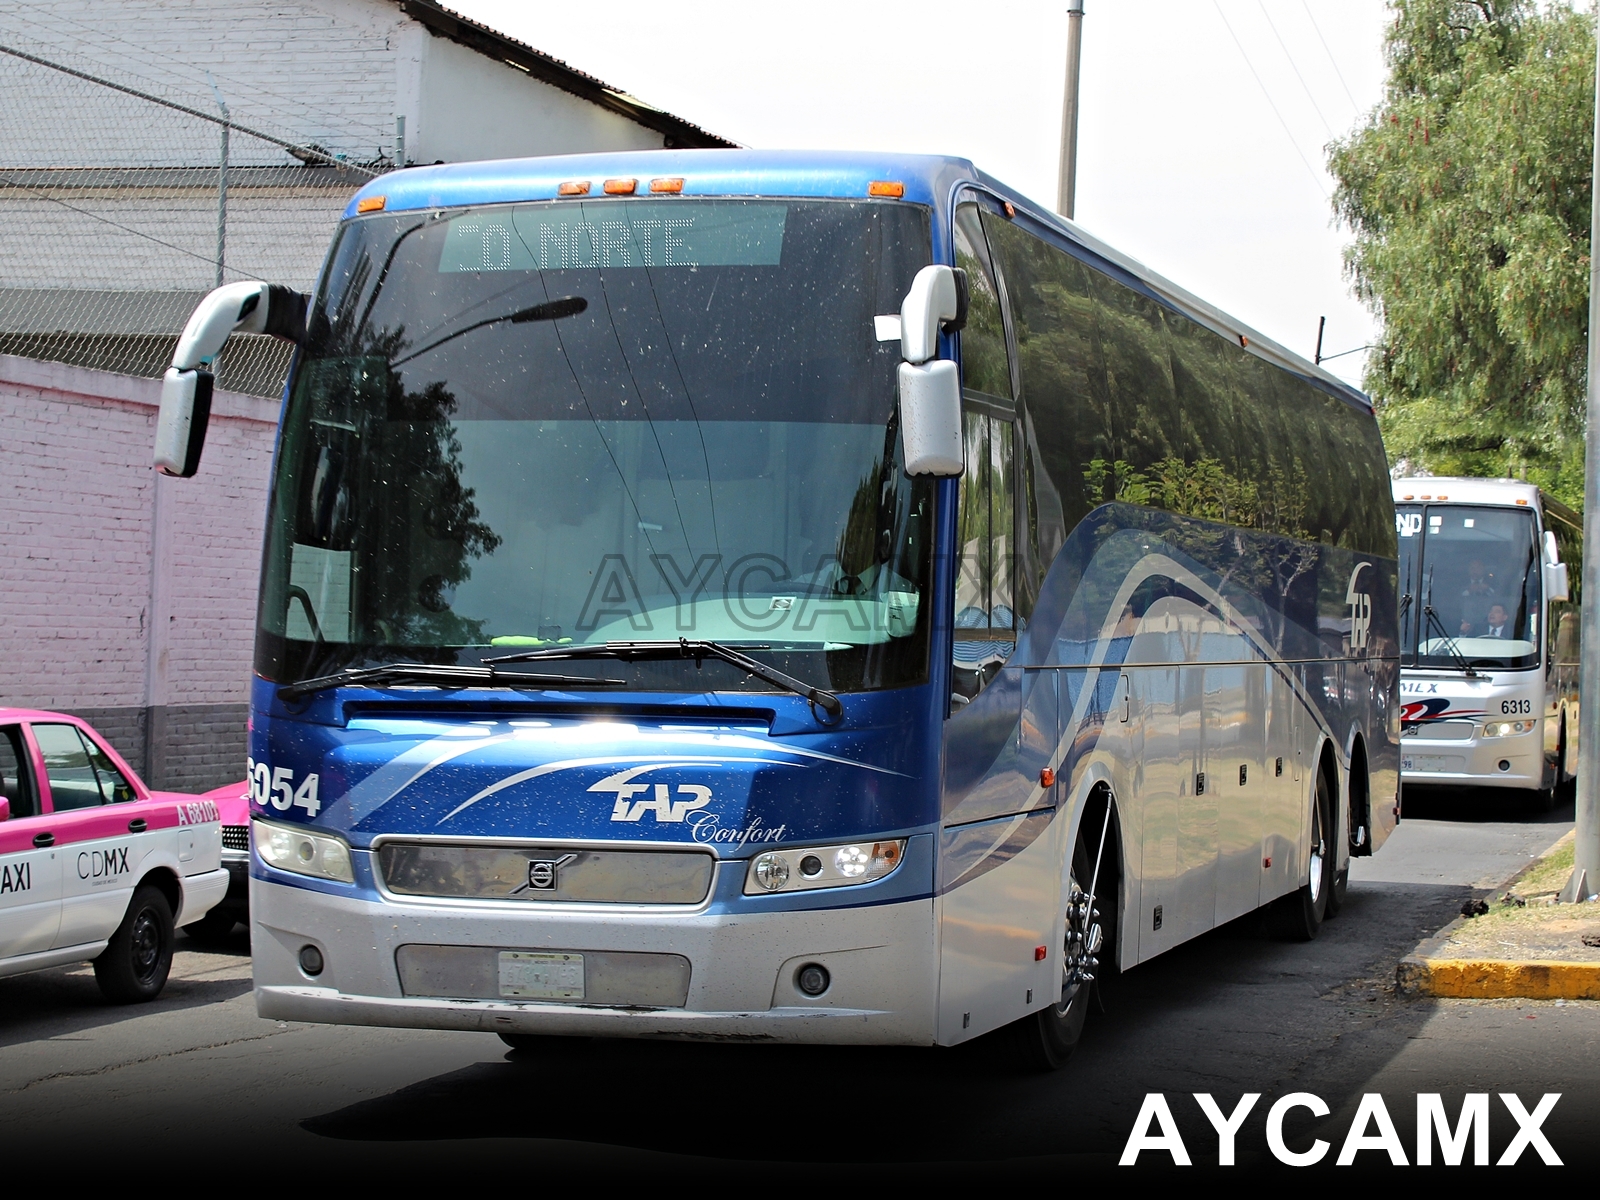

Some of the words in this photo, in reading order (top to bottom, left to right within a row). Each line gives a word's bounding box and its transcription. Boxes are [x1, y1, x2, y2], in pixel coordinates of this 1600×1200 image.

[540, 218, 698, 269] NORTE
[1501, 699, 1531, 714] 6313
[586, 763, 722, 822] TAP
[177, 804, 188, 826] A
[685, 809, 787, 853] Confort
[0, 861, 31, 894] AXI
[77, 847, 129, 879] CDMX
